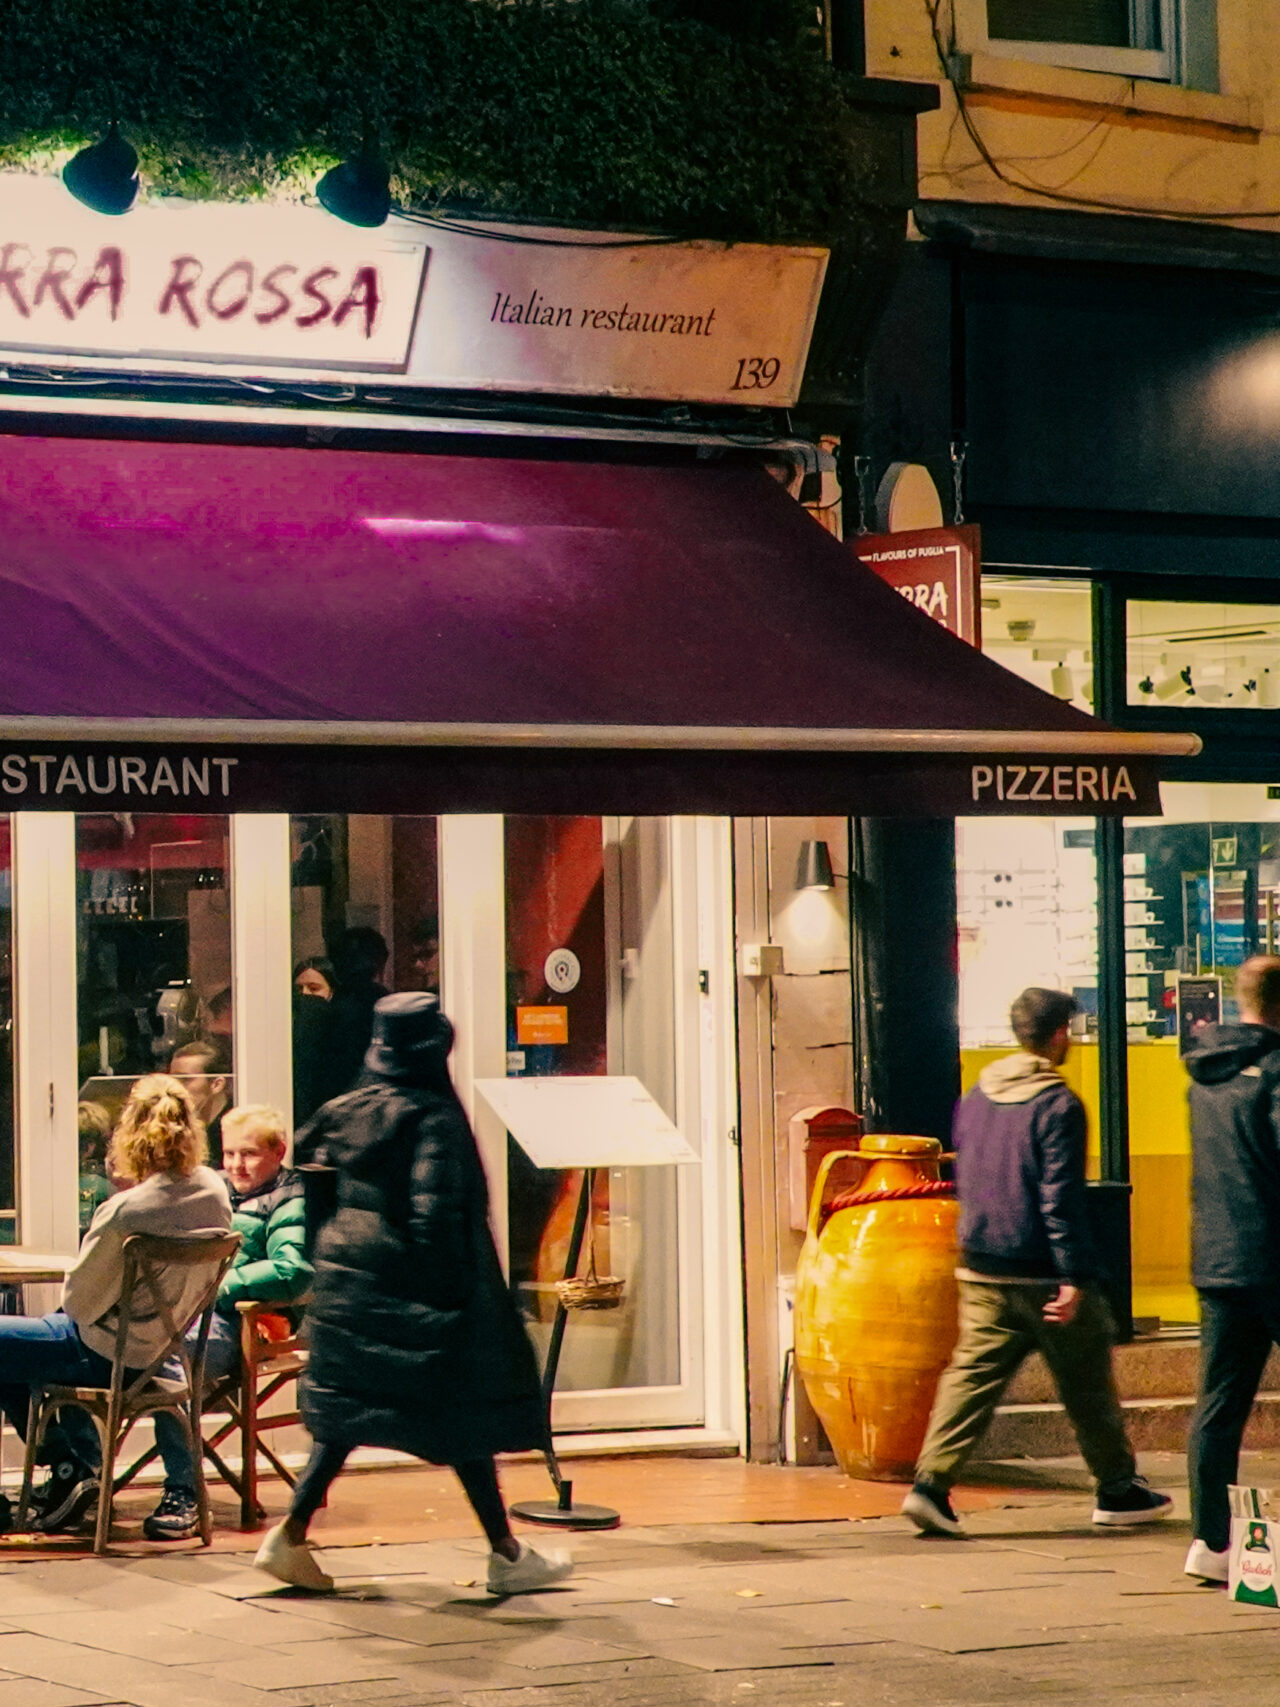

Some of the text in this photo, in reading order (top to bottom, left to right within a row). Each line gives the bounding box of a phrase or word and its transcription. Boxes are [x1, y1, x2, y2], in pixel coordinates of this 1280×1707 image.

[158, 255, 381, 340] ROSSA
[490, 289, 717, 337] Italian restaurant
[729, 357, 780, 391] 139
[872, 546, 945, 562] FLAVOURS OF PUGLIA
[972, 765, 1137, 801] PIZZERIA
